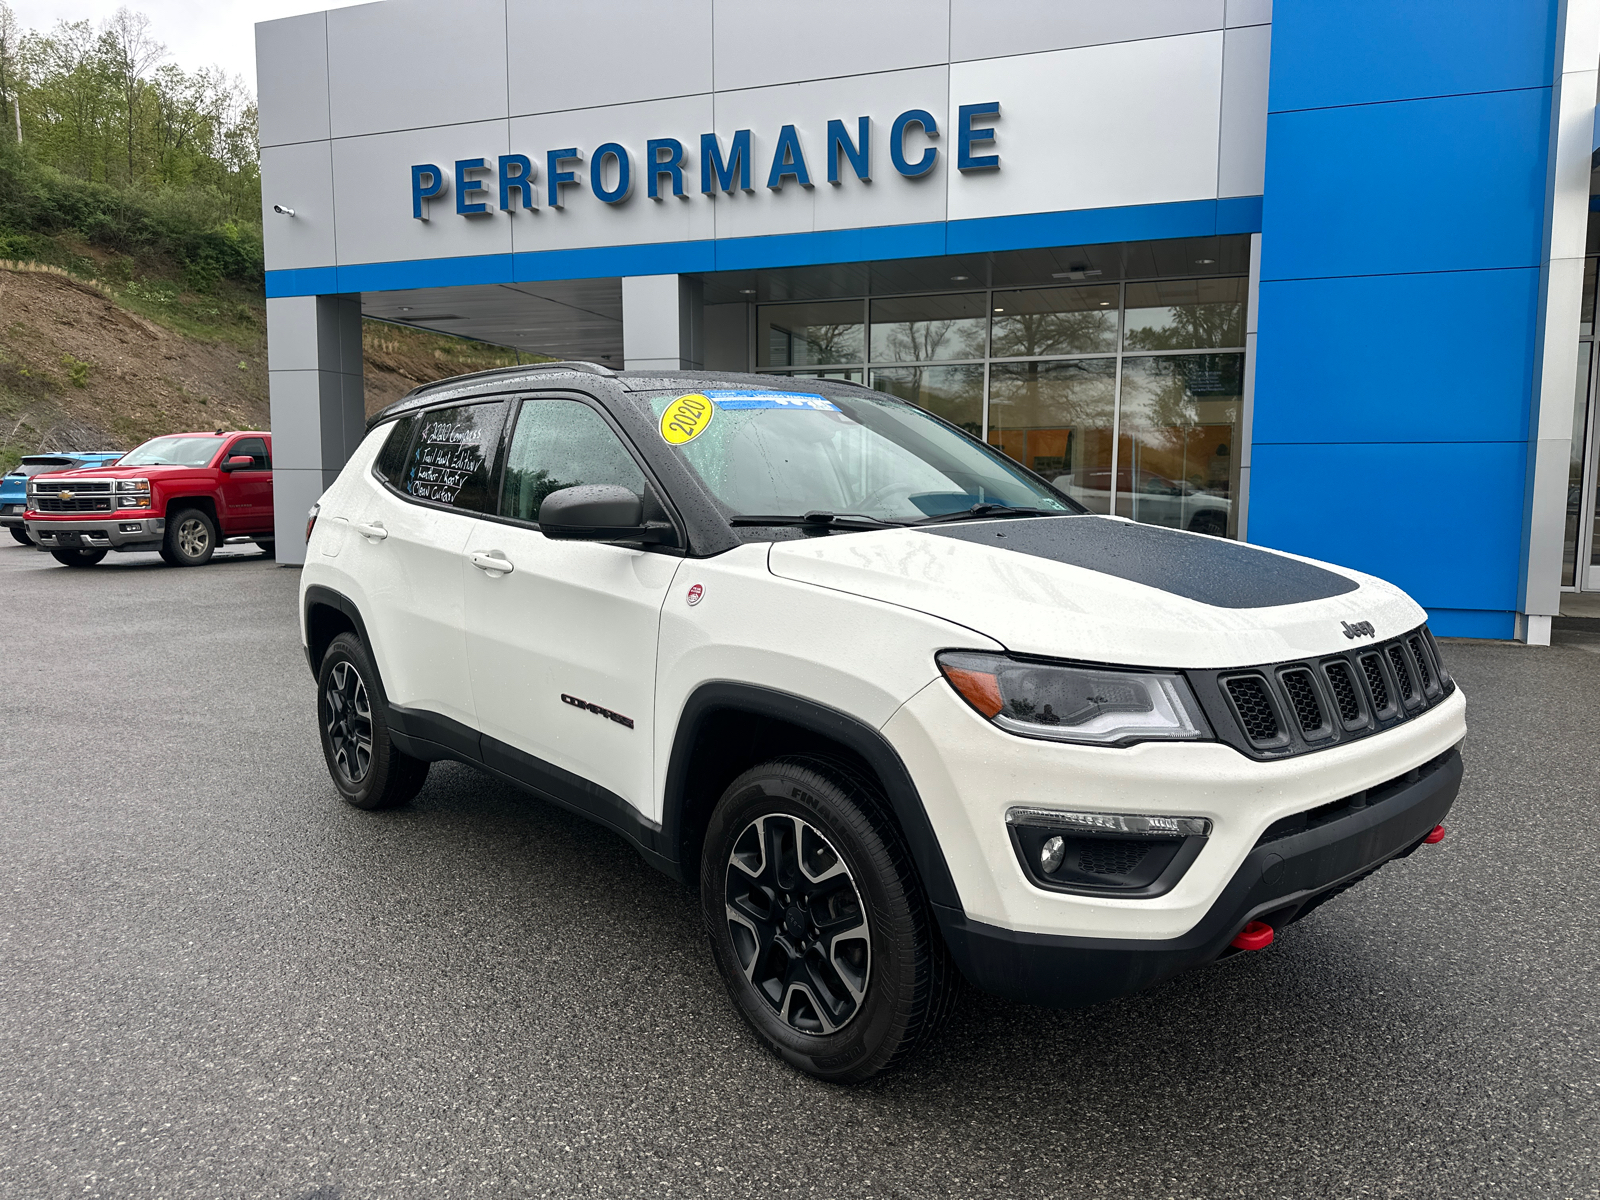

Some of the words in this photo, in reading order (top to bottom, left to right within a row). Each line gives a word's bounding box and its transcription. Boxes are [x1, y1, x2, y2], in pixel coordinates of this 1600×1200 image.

[411, 101, 1002, 222] PERFORMANCE
[668, 399, 706, 437] 2020
[1340, 620, 1375, 640] Jeep
[561, 693, 634, 730] COMPASS
